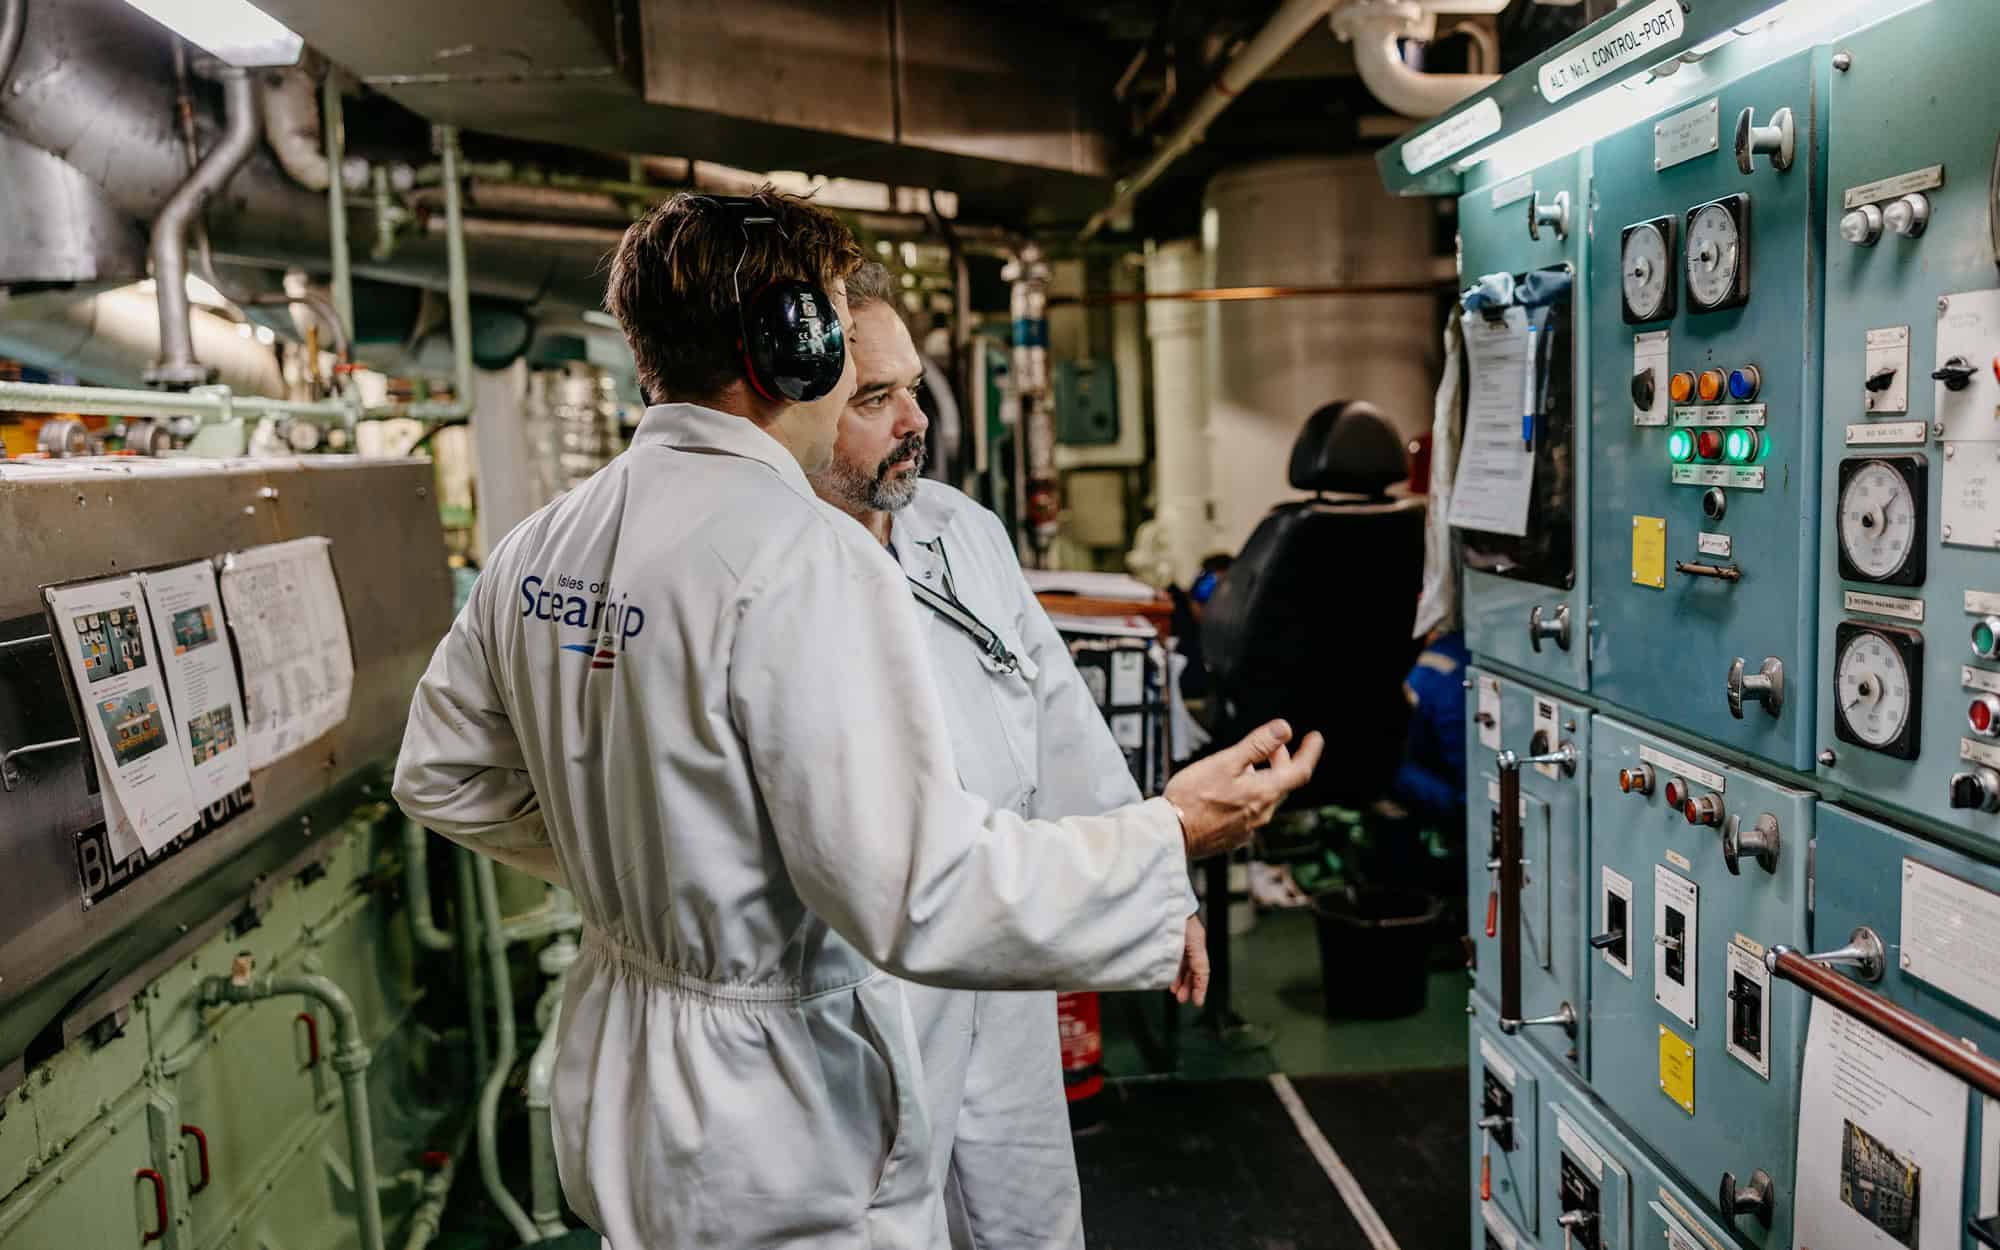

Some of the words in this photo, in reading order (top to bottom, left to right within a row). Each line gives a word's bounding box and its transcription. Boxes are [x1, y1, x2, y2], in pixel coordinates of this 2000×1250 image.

[1592, 9, 1676, 67] CONTROL-PORT
[558, 573, 584, 591] Isles
[590, 580, 606, 594] of
